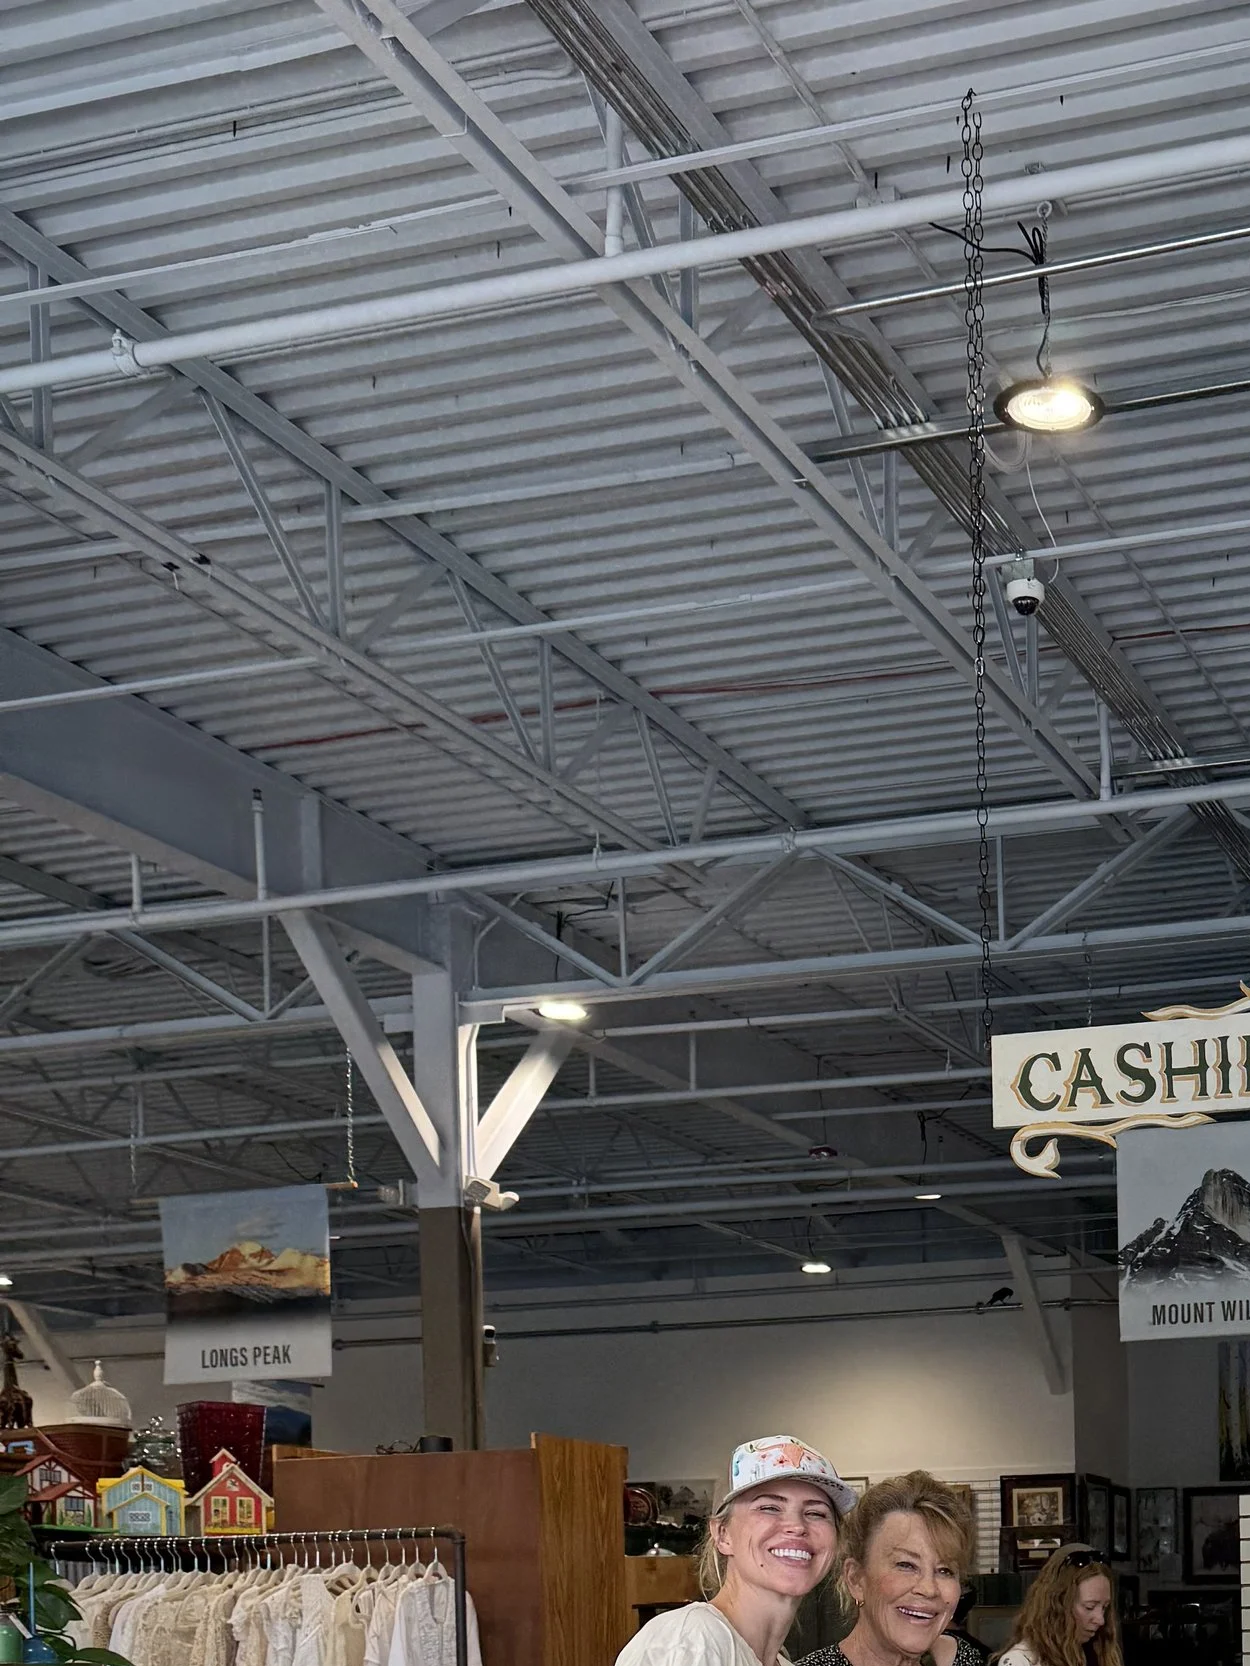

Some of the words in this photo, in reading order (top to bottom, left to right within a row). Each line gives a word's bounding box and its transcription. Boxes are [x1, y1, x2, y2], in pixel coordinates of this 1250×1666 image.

[1151, 1301, 1215, 1326] MOUNT
[201, 1347, 248, 1369] LONGS
[253, 1344, 292, 1366] PEAK
